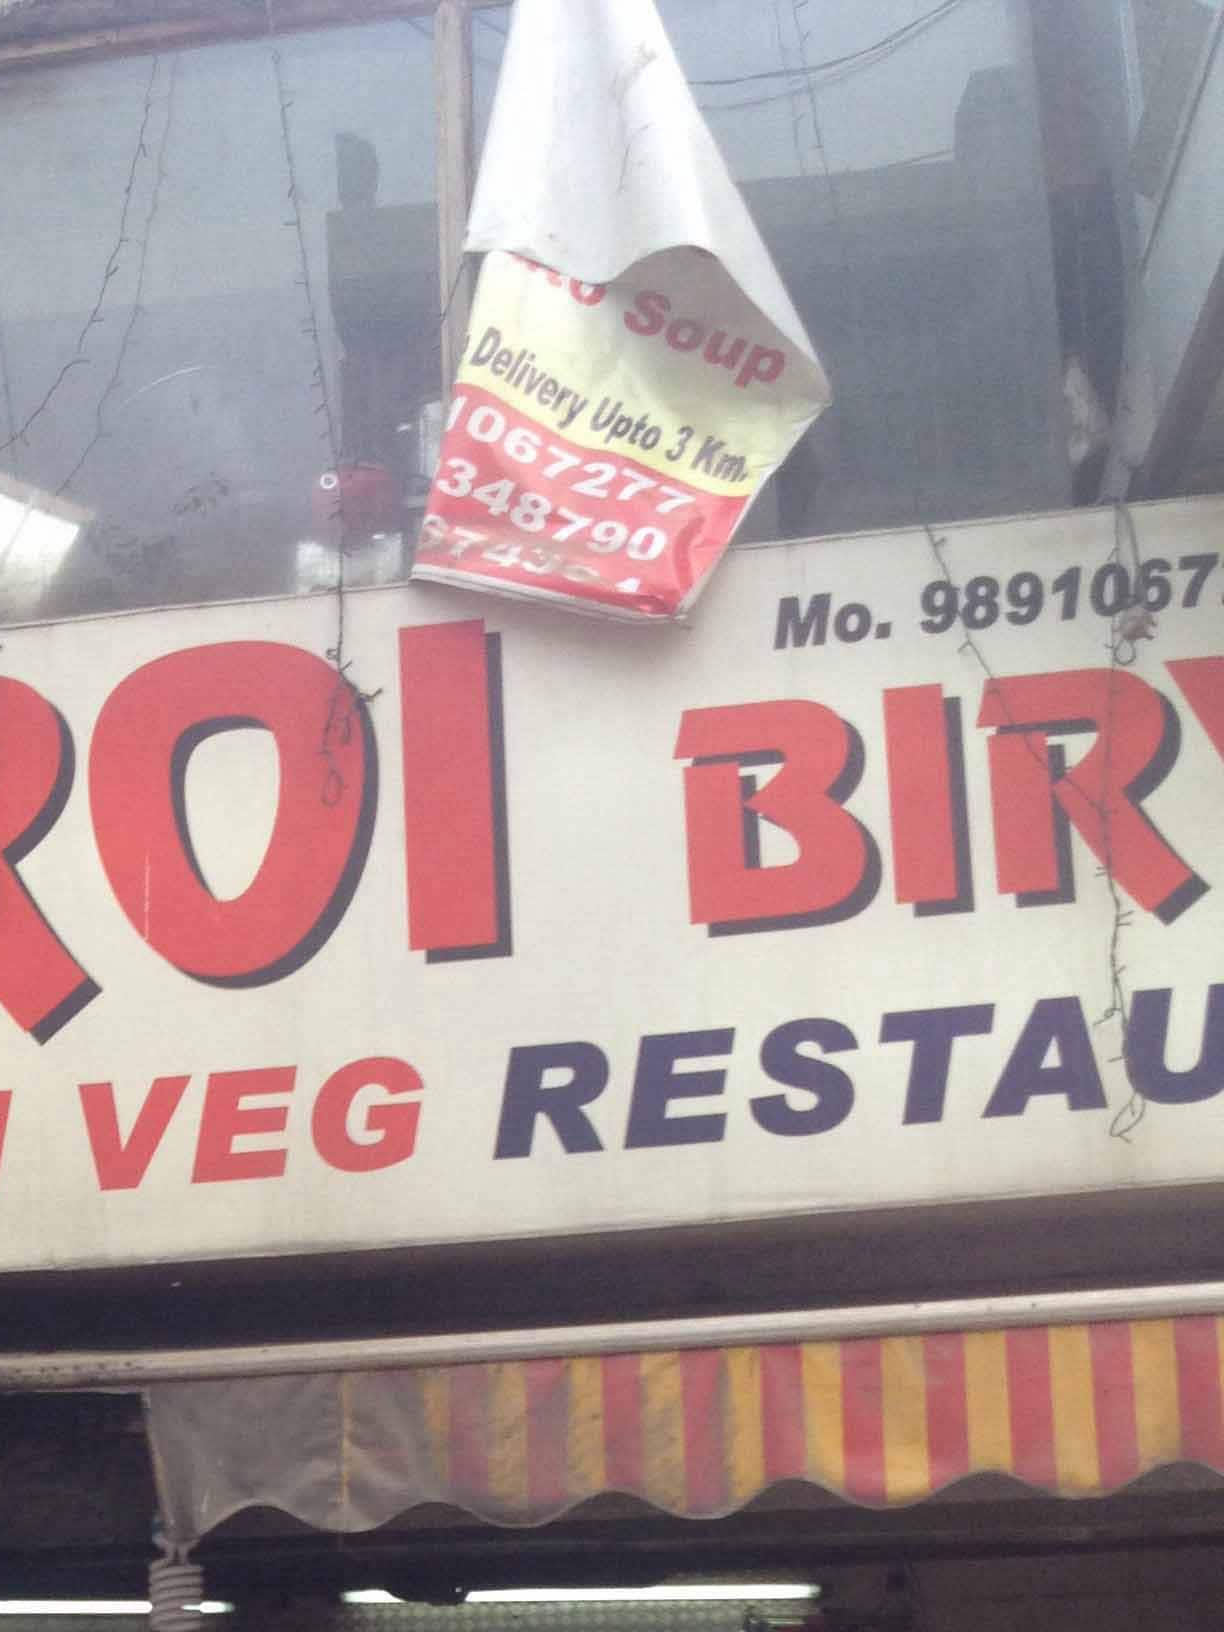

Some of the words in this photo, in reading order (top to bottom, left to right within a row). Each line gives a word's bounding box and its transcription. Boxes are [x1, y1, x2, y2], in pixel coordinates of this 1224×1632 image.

[624, 289, 786, 390] Soup
[469, 325, 588, 430] Delivery
[590, 397, 663, 452] Upto
[665, 425, 695, 462] 3
[436, 457, 668, 562] 348790
[774, 593, 892, 650] Mo.
[920, 552, 1224, 635] 9891067
[79, 1057, 422, 1191] VEG
[494, 983, 1224, 1159] RESTAU
